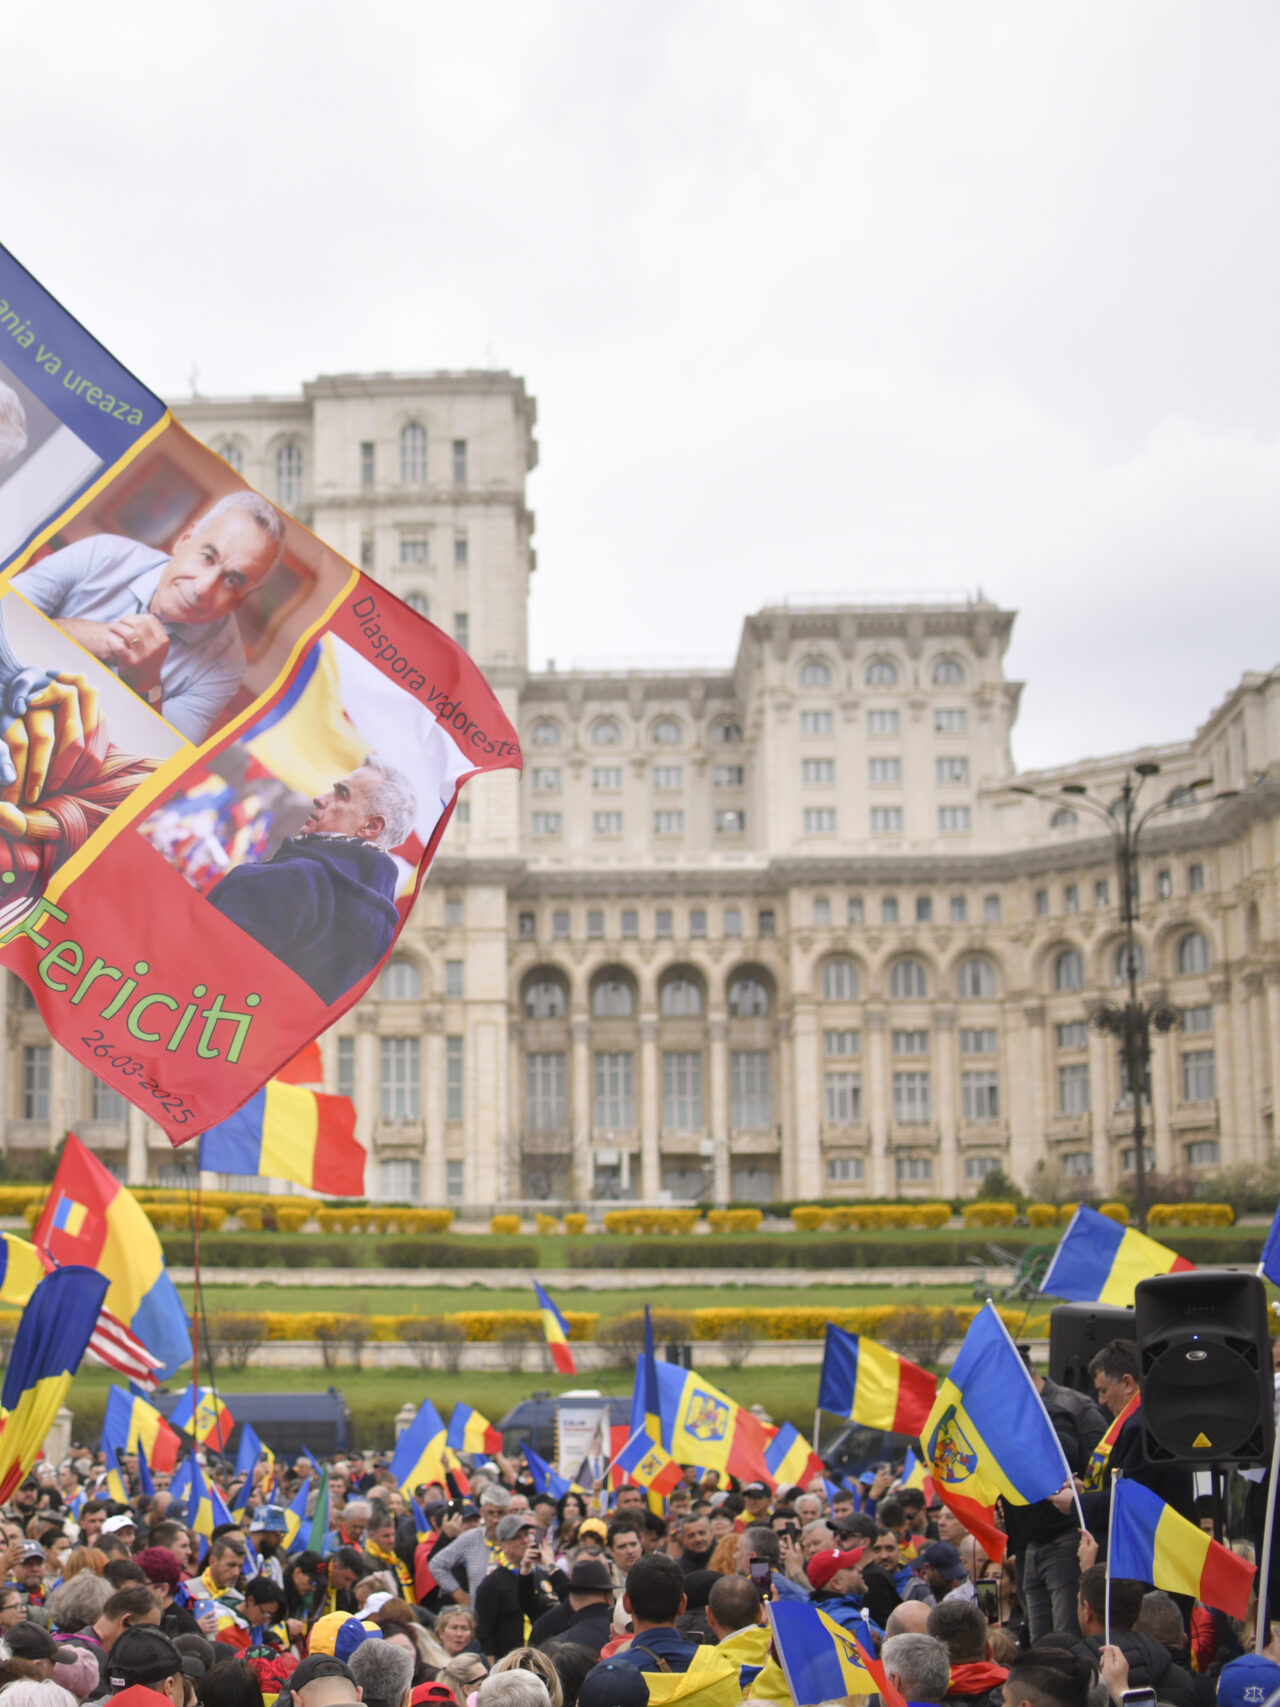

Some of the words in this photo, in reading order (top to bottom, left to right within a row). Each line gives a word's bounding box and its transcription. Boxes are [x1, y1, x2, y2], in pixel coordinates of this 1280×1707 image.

[35, 345, 62, 375] va
[63, 369, 144, 426] ureaza
[352, 595, 426, 691] Diaspora
[81, 1029, 195, 1125] 26-03-2025
